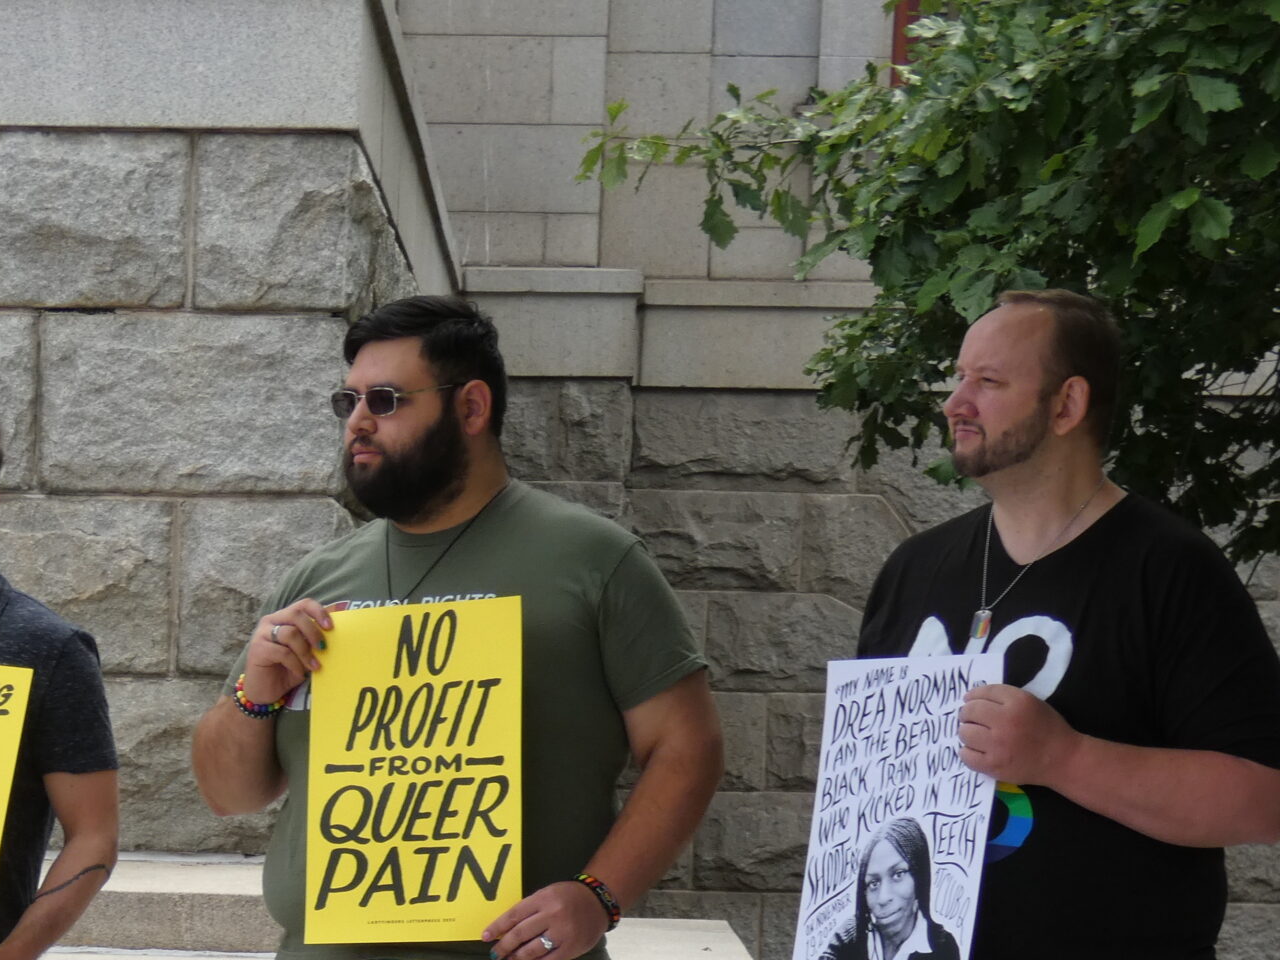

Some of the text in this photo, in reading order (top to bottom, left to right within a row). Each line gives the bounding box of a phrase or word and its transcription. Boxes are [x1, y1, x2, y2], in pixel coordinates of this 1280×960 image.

[393, 609, 457, 679] NO
[863, 666, 895, 690] NAME
[900, 665, 909, 680] IS
[345, 677, 502, 752] PROFIT
[831, 688, 886, 745] DREA
[890, 659, 973, 727] NORMAN
[369, 753, 463, 777] FROM
[824, 707, 962, 772] I AM THE BEAUTI
[319, 774, 510, 845] QUEER
[818, 772, 985, 847] WHO KICKED IN THE
[820, 760, 872, 812] BLACK
[876, 753, 919, 791] TRANS
[314, 843, 512, 911] PAIN
